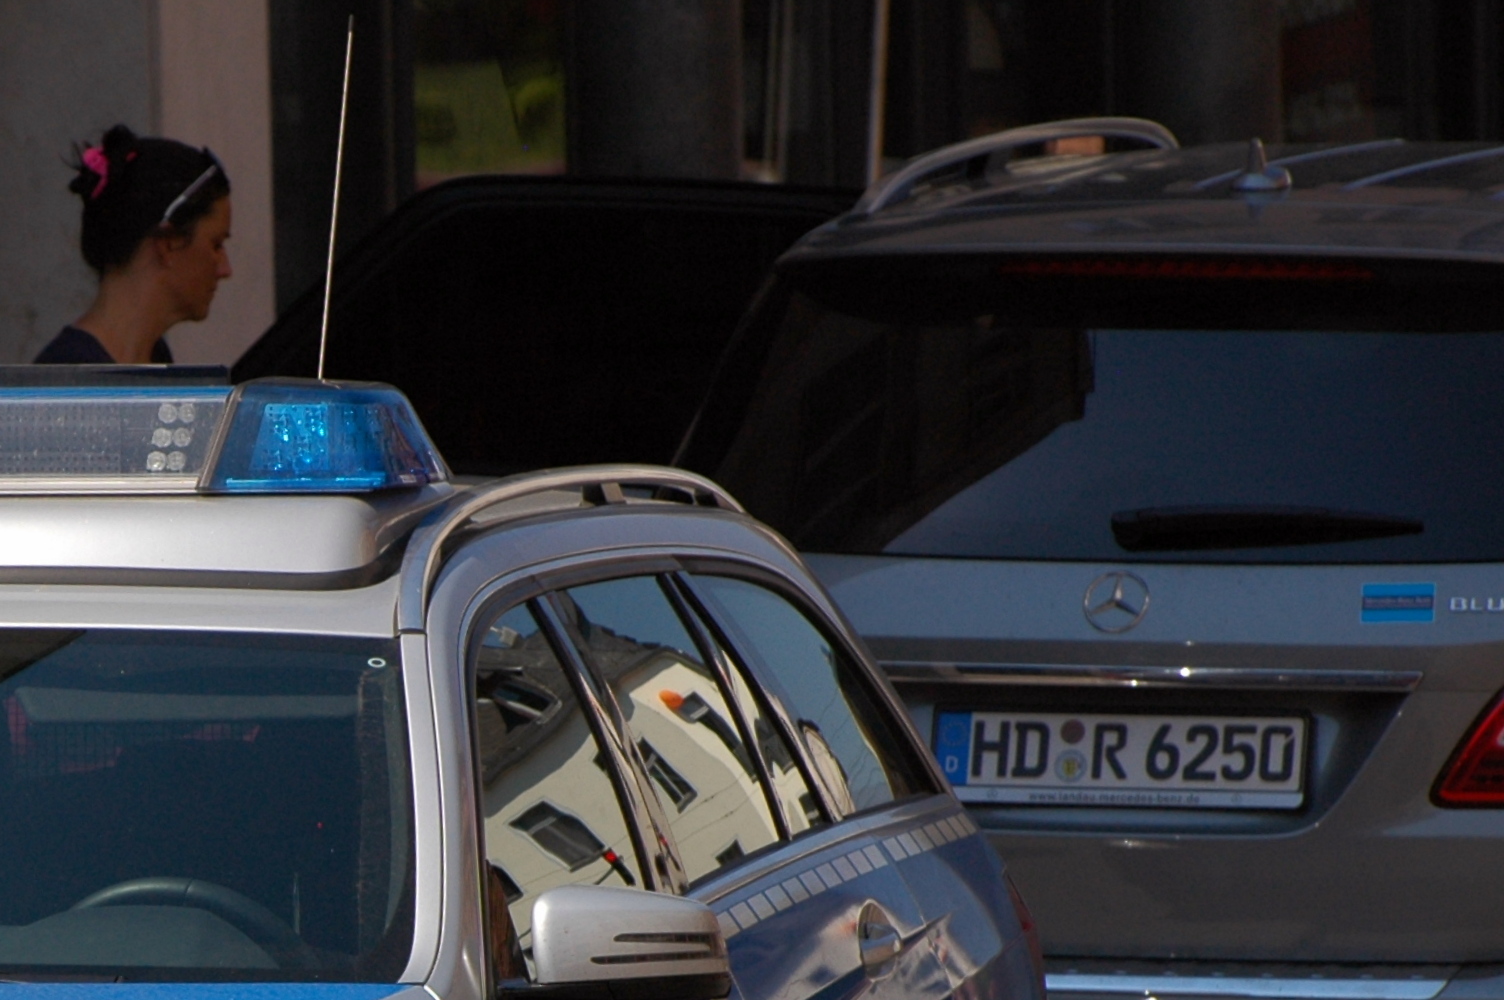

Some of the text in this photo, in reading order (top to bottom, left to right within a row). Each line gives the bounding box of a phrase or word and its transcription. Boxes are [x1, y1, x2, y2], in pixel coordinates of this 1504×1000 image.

[1449, 596, 1504, 612] BLU
[945, 720, 1296, 782] D HD R 6250
